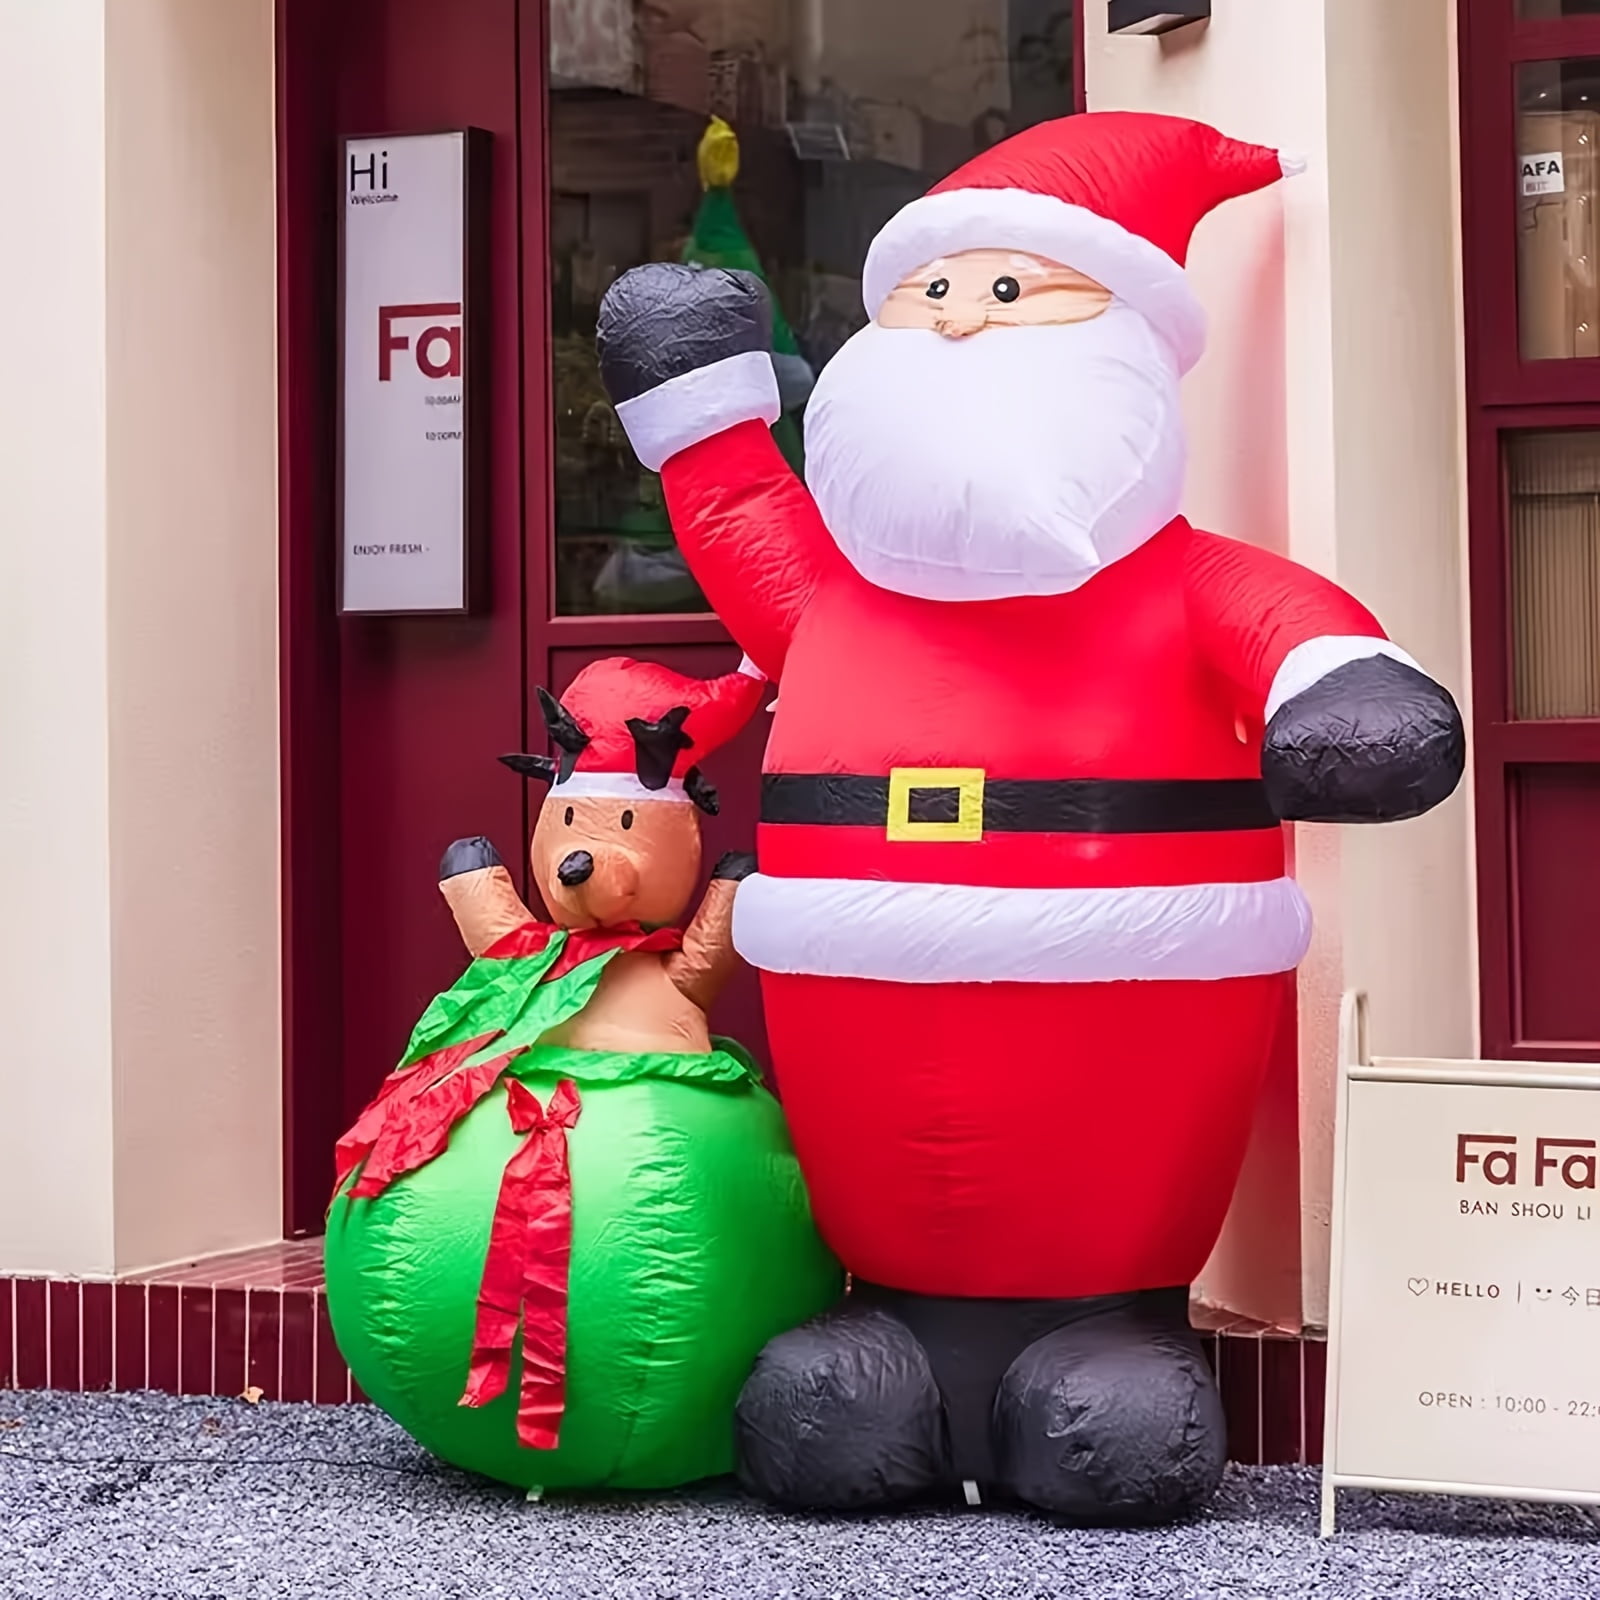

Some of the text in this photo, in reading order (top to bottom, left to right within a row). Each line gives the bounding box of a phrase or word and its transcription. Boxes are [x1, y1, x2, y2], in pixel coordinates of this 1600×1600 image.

[350, 150, 388, 192] Hi
[378, 302, 461, 382] Fa
[353, 543, 423, 556] ENJOY FRESH
[1456, 1133, 1597, 1190] Fa Fa
[1459, 1200, 1592, 1221] BAN SHOU LI
[1436, 1282, 1500, 1299] HELLO
[1561, 1286, 1600, 1306] 今日
[1419, 1391, 1473, 1408] OPEN
[1496, 1396, 1546, 1414] 10:00
[1568, 1400, 1600, 1417] 22:
